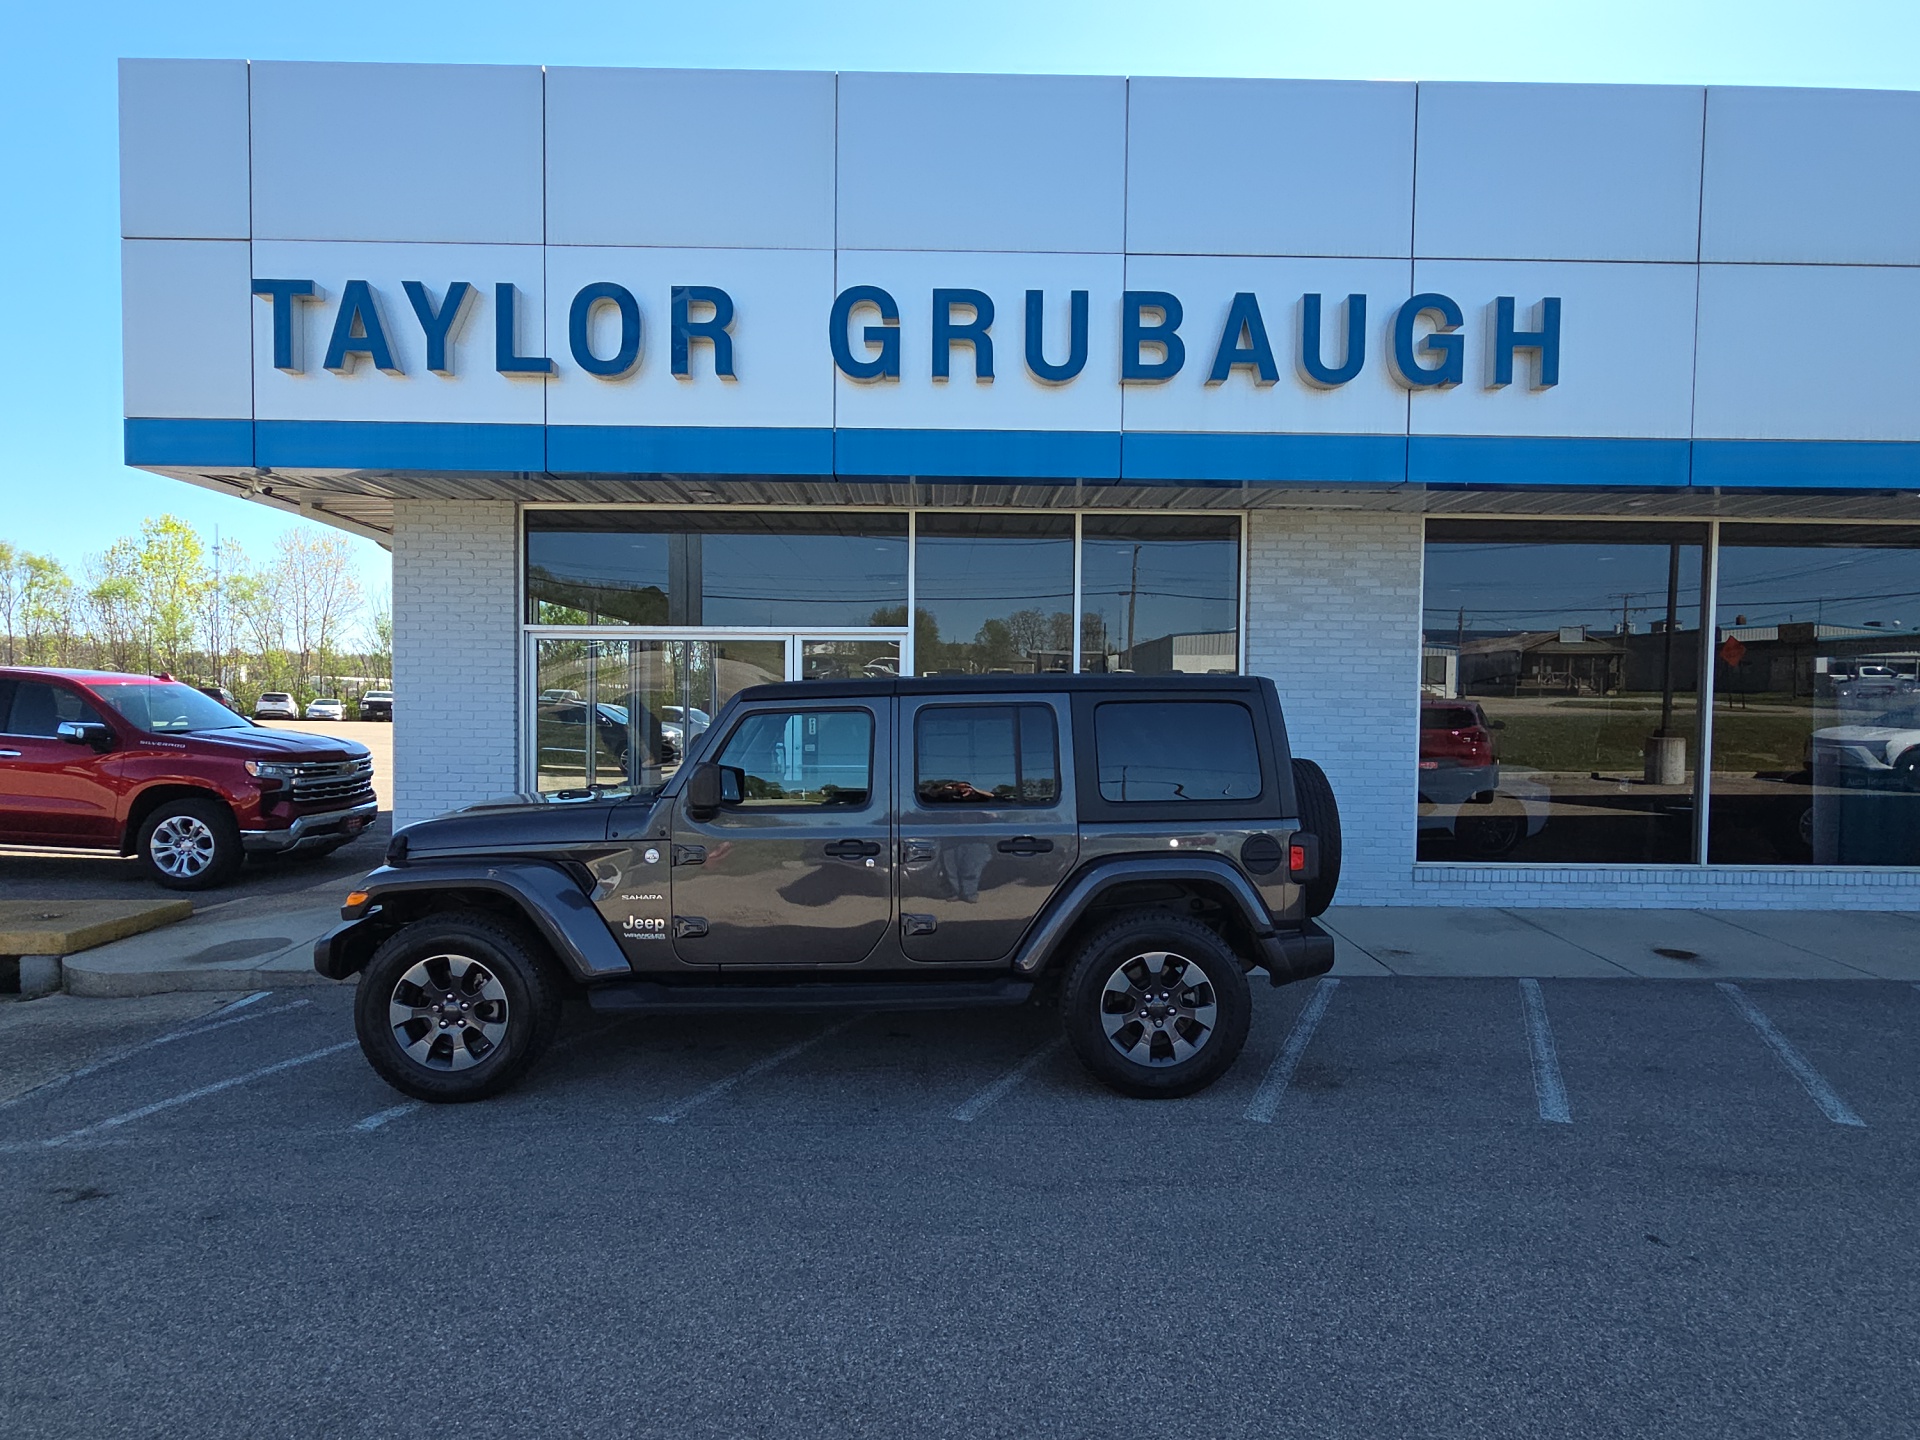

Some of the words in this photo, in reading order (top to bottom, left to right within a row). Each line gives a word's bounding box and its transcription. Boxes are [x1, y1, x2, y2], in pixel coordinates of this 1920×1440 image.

[252, 279, 737, 381] TAYLOR
[829, 286, 1561, 391] GRUBAUGH
[139, 740, 186, 749] SILVERADO
[622, 915, 665, 932] Jeep
